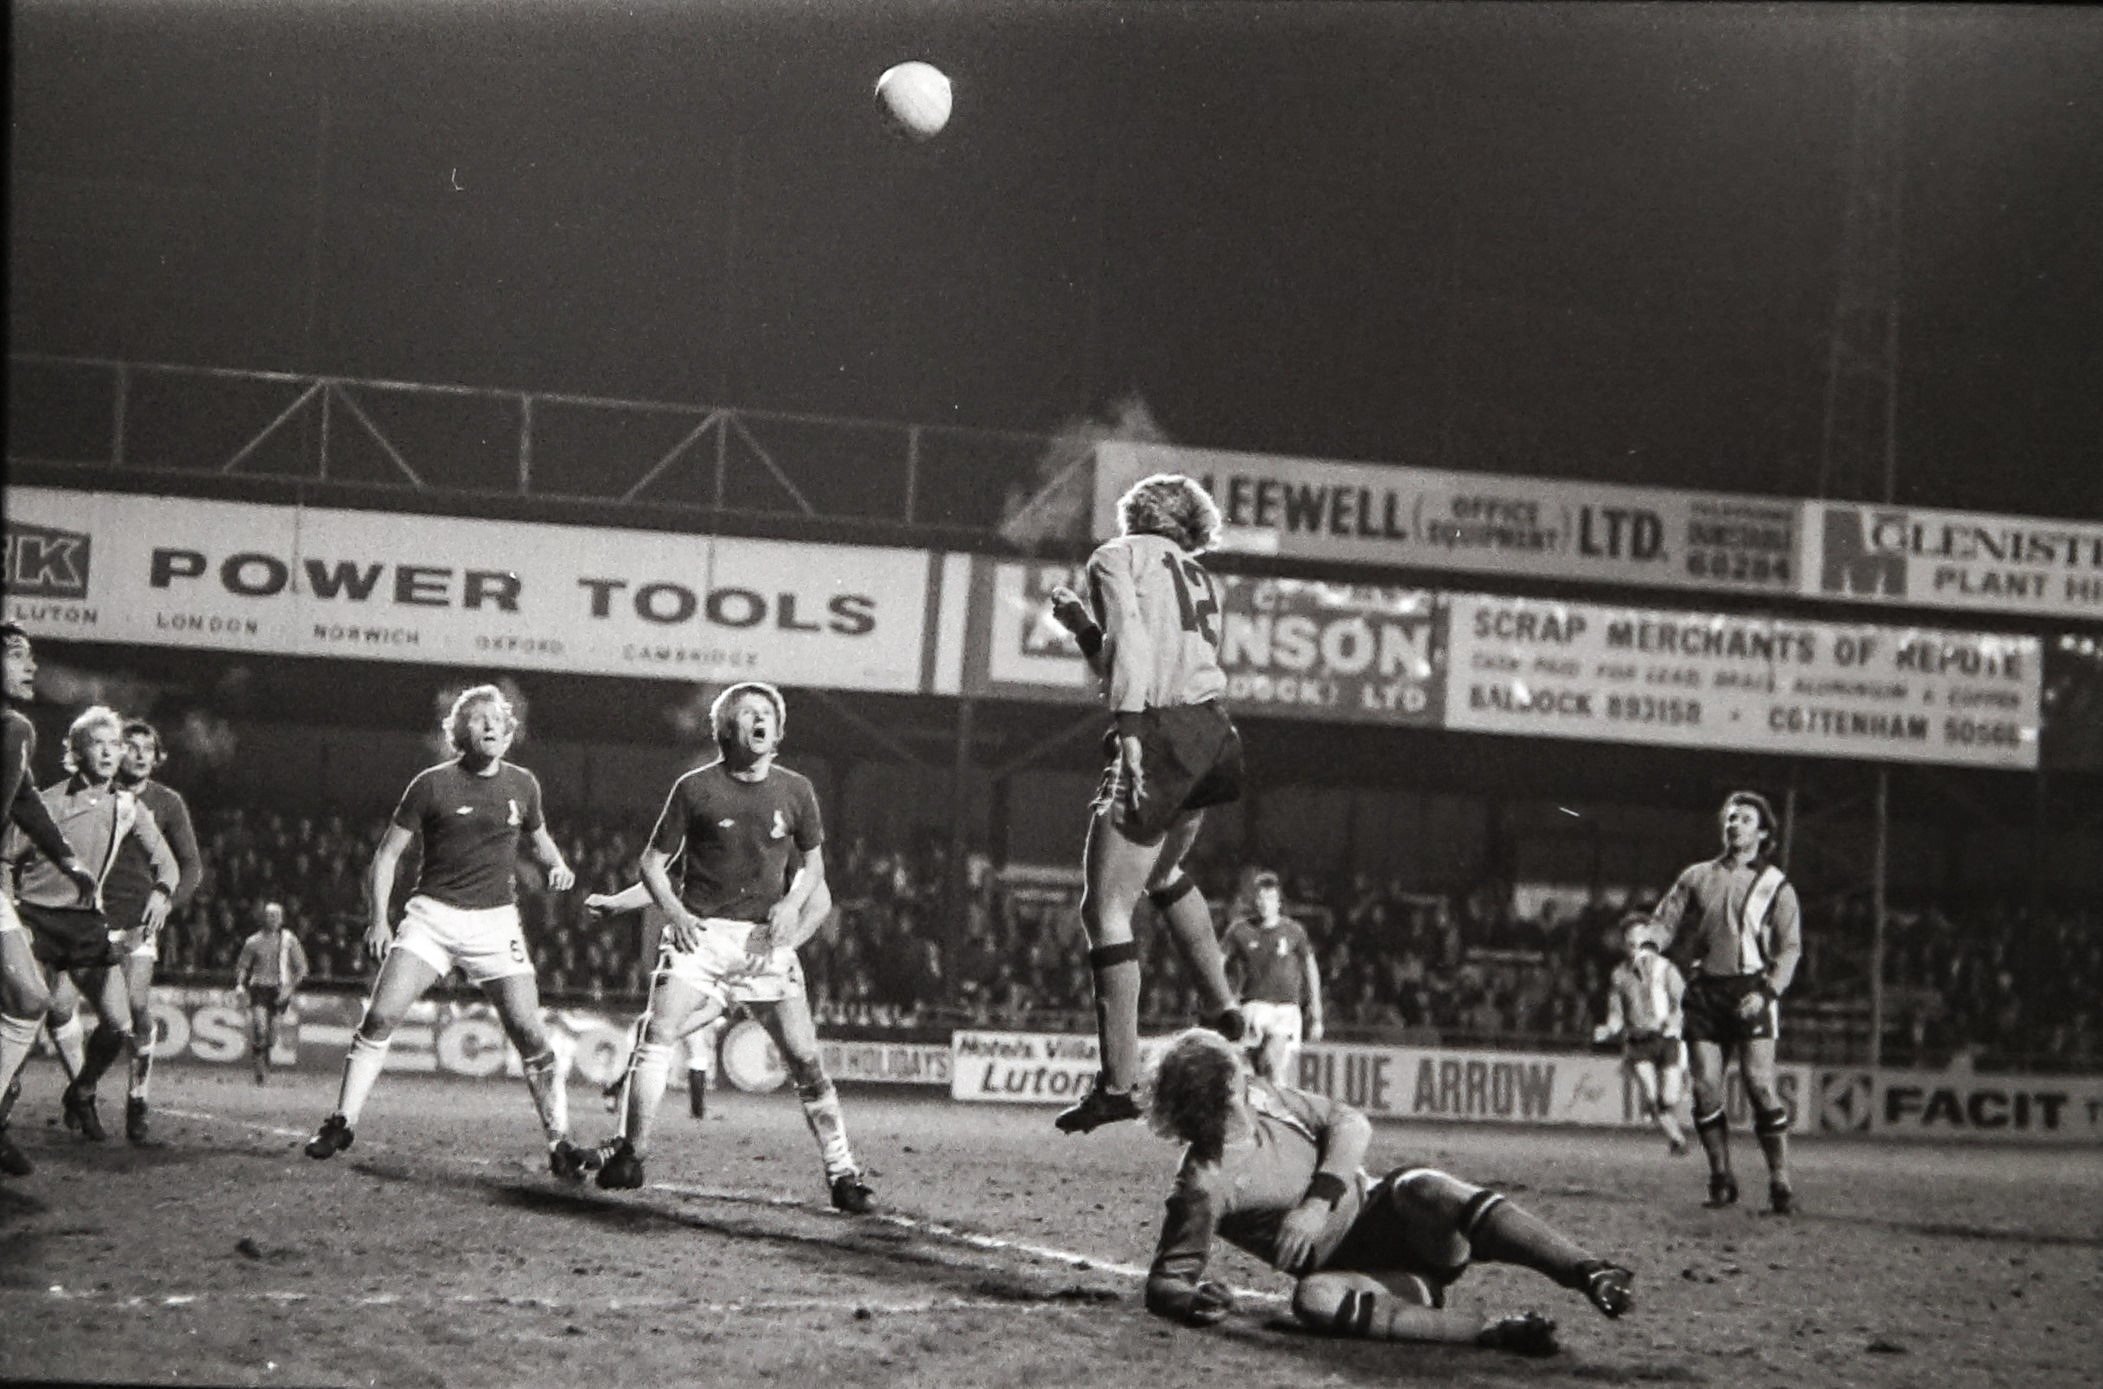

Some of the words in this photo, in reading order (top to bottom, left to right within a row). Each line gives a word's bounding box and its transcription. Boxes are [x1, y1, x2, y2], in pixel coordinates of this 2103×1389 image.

[1203, 475, 1406, 540] EEWELL
[150, 547, 521, 613] POWER
[577, 577, 878, 636] TOOLS
[1162, 551, 1219, 649] 12
[1933, 566, 2047, 598] PLANT
[16, 603, 98, 625] LUTON
[156, 611, 258, 635] LONDON
[314, 623, 420, 645] NORWICH
[1220, 612, 1432, 678] NSON
[1473, 607, 1588, 643] SCRAP
[1606, 620, 1815, 664] MERCHANTS
[1834, 635, 1876, 667] OF
[1896, 641, 2022, 682] REPUTE
[981, 1065, 1098, 1096] Luton
[1299, 1052, 1392, 1108] BLUE
[1412, 1057, 1557, 1117] ARROW
[1885, 1084, 2068, 1130] FACIT
